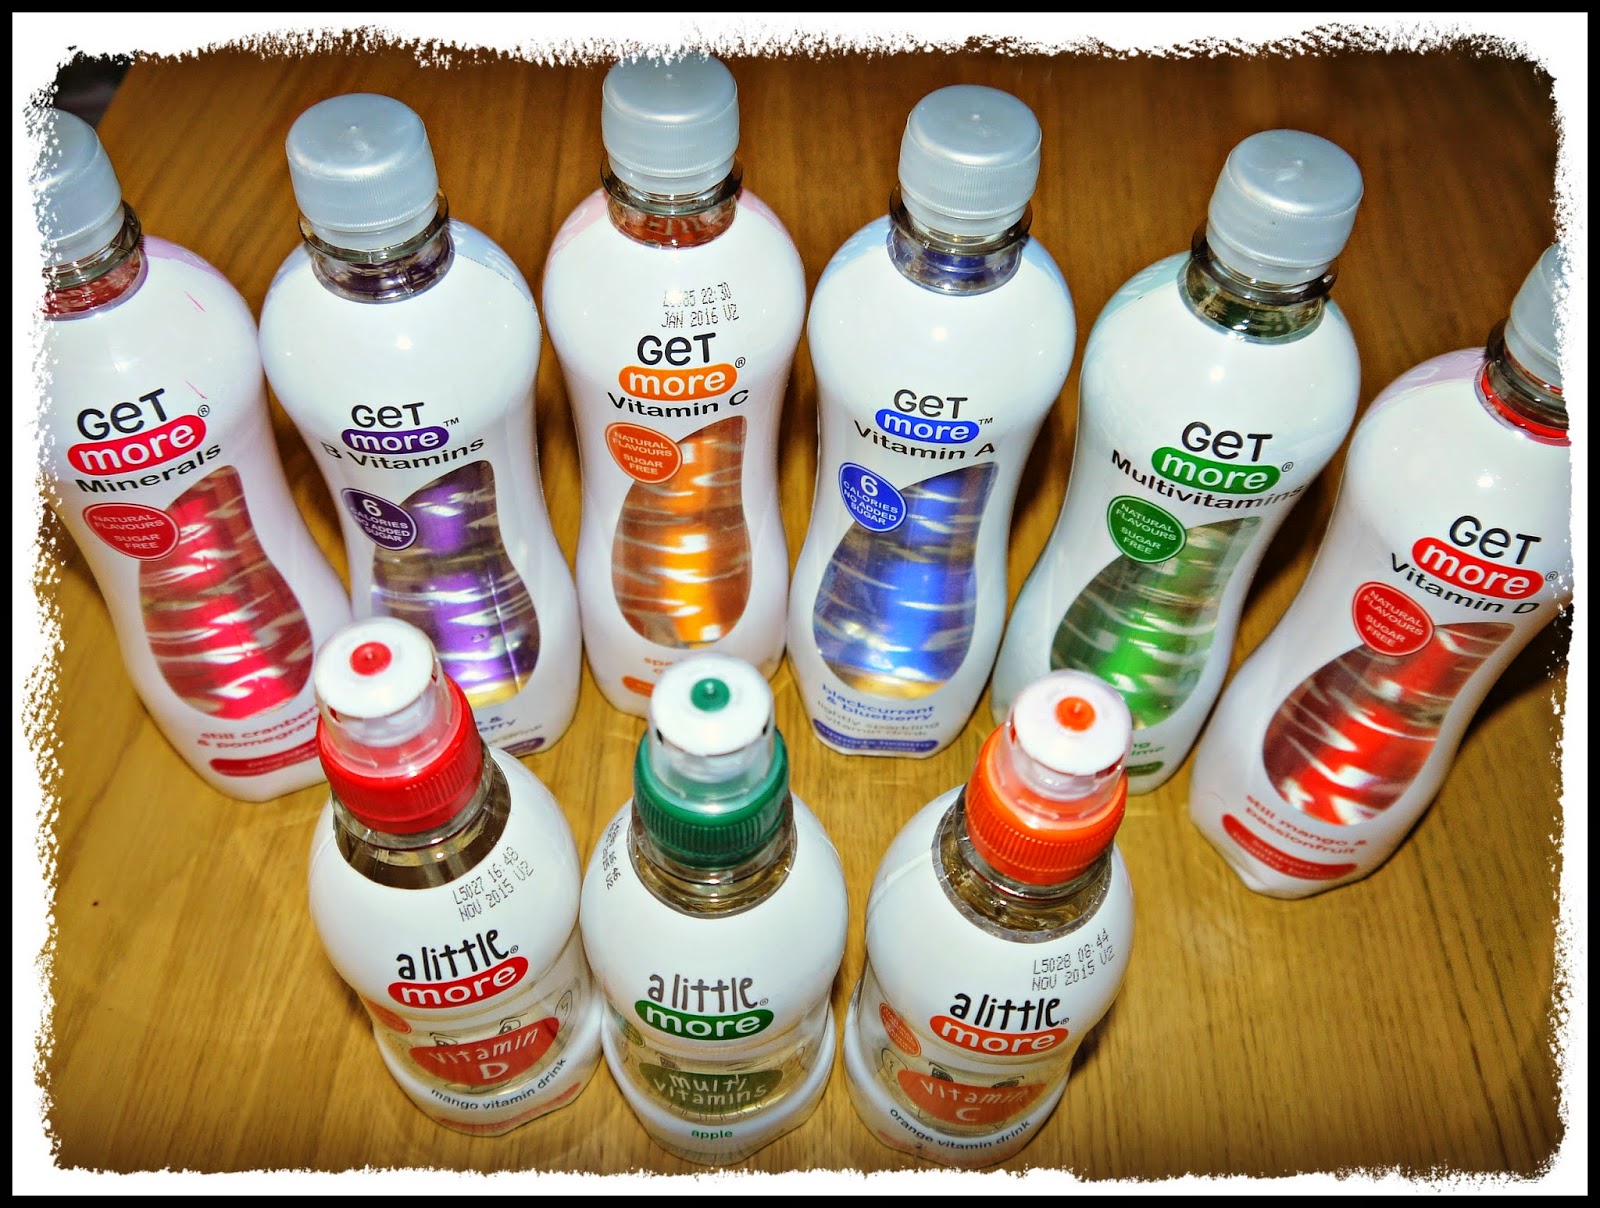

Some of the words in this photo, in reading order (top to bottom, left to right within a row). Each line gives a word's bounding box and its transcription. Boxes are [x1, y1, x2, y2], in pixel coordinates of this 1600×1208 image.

[701, 282, 732, 304] 22:30
[661, 311, 683, 328] JAN
[690, 307, 719, 327] 2016
[629, 371, 726, 396] more
[607, 392, 719, 418] Vitamin
[729, 389, 749, 406] C
[614, 431, 668, 449] NATURAL
[854, 420, 966, 460] Vitamin
[974, 442, 996, 457] A
[883, 413, 970, 441] more
[79, 424, 196, 470] more
[321, 441, 342, 459] B
[347, 438, 484, 470] Vitamins
[350, 431, 439, 451] more
[612, 438, 673, 457] FLAVOURS
[75, 444, 222, 493] Minerals
[623, 453, 663, 468] SUGAR
[629, 463, 658, 475] FREE
[1161, 453, 1268, 490] more
[860, 475, 878, 497] 6
[1112, 450, 1304, 509] Multivitamins
[362, 499, 382, 518] 6
[843, 480, 899, 514] CALORIES
[843, 489, 857, 504] NO
[859, 501, 897, 523] ADDED
[93, 513, 157, 524] NATURAL
[94, 520, 164, 531] FLAVOURS
[351, 507, 408, 529] CALORIES
[850, 501, 886, 526] SUGAR
[1115, 509, 1176, 541] FLAVOURS
[1120, 503, 1174, 533] NATURAL
[114, 533, 161, 543] SUGAR
[365, 526, 402, 542] SUGAR
[371, 523, 410, 537] ADDED
[1121, 526, 1161, 550] SUGAR
[125, 541, 160, 550] FREE
[1123, 536, 1153, 555] FREE
[1422, 544, 1530, 595] more
[1391, 552, 1504, 613] Vitamin
[1512, 602, 1540, 614] D
[1363, 595, 1424, 636] FLAVOURS
[1369, 590, 1423, 627] NATURAL
[1364, 614, 1406, 643] SUGAR
[1366, 625, 1396, 647] FREE
[821, 683, 936, 715] blackcurrant
[842, 703, 933, 721] blueberry
[1245, 807, 1357, 854] passionfruit
[1279, 820, 1348, 846] mango
[459, 899, 482, 922] NOV
[485, 878, 514, 908] 2015
[1032, 974, 1057, 991] NOV
[1064, 959, 1095, 986] 2015
[1033, 954, 1071, 975] L5028
[401, 966, 517, 1005] more
[646, 1006, 760, 1037] more
[942, 1021, 1056, 1053] more
[431, 1089, 479, 1110] mango
[482, 1087, 536, 1110] vitamin
[537, 1058, 567, 1089] drink
[479, 1062, 509, 1080] D
[956, 1107, 981, 1121] C
[691, 1129, 733, 1140] apple
[890, 1108, 933, 1143] orange
[938, 1139, 992, 1151] vitamin
[996, 1120, 1030, 1144] drink
